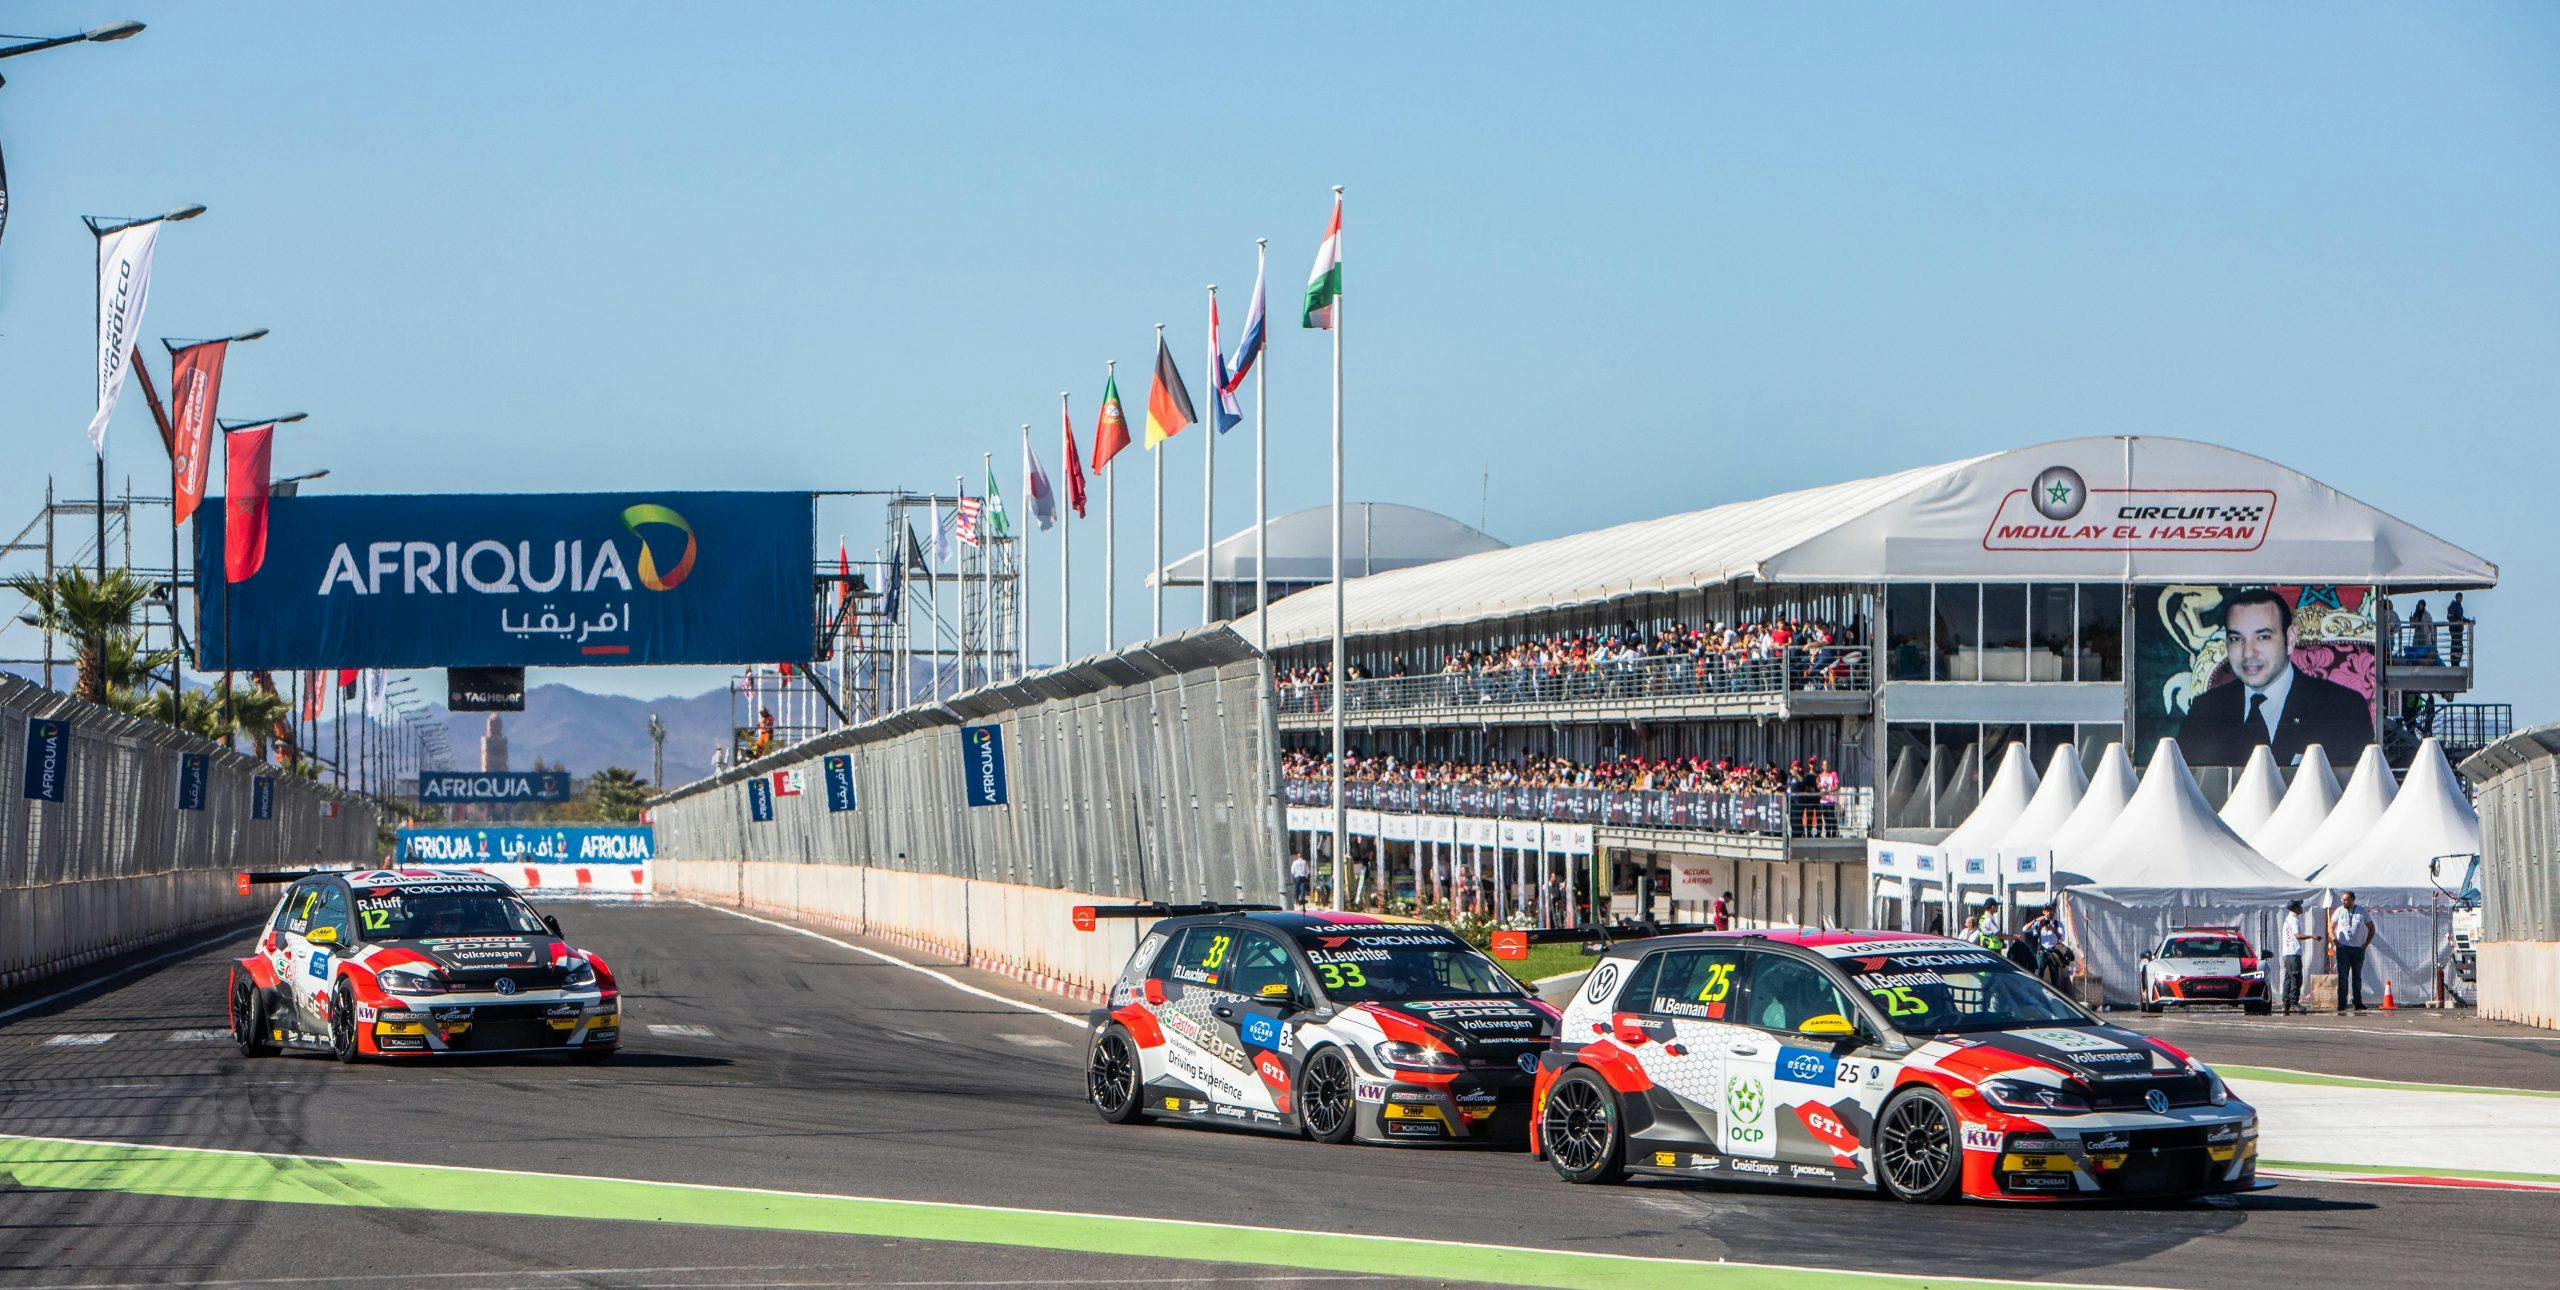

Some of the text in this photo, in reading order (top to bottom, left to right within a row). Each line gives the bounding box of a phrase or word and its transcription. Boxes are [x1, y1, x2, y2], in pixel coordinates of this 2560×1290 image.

[109, 258, 131, 378] OROCCO
[2117, 506, 2221, 520] CIRCUIT
[1997, 525, 2256, 539] MOULAY EL HASSAN
[317, 539, 633, 595] AFRIQUIA
[501, 602, 630, 643] افريقيا
[42, 736, 58, 798] AFRIQUIA
[981, 743, 997, 802] AFRIQUIA
[424, 777, 532, 798] AFRIQUIA
[404, 836, 474, 860] AFRIQUIA
[580, 835, 650, 859] AFRIQUIA
[368, 875, 487, 885] Volkswagen
[399, 885, 497, 895] YOKOHAMA
[357, 897, 401, 911] R.Huff
[360, 910, 391, 931] 12
[1305, 924, 1434, 933] Volkswagen
[432, 942, 532, 952] EDGE
[1350, 935, 1456, 946] YOKOHAMA
[1837, 941, 1969, 954] Volkswagen
[453, 951, 523, 960] Volkswagen
[1202, 935, 1231, 968] 33
[1307, 948, 1392, 965] B.Leuchter
[1889, 953, 1998, 967] YOKOHAMA
[1174, 964, 1210, 983] B.Leuchter
[1319, 962, 1367, 989] 33
[1852, 968, 1944, 991] M.Bennani
[1262, 984, 1288, 994] OMP
[1698, 963, 1736, 1002] 25
[1432, 1000, 1515, 1008] Castrol
[1653, 997, 1710, 1018] M.Bennani
[1870, 986, 1929, 1017] 25
[358, 1007, 376, 1019] KW
[1428, 1008, 1536, 1020] EDGE
[1171, 1013, 1198, 1040] Castrol
[1249, 1025, 1273, 1038] OSCARO
[1459, 1020, 1533, 1031] Volkswagen
[1197, 1029, 1247, 1069] EDGE
[2067, 1051, 2145, 1063] Volkswagen
[1262, 1061, 1285, 1083] GTI
[1787, 1060, 1825, 1074] OSCARO
[1837, 1063, 1860, 1083] 25
[1168, 1049, 1243, 1101] Driving Experience
[1358, 1085, 1384, 1100] KW
[1402, 1107, 1424, 1115] OMP
[1808, 1112, 1845, 1139] GTI
[1731, 1127, 1764, 1142] OCP
[1967, 1131, 2001, 1147] KW
[1656, 1154, 1676, 1165] OMP
[1731, 1158, 1780, 1176] CroisiEurope
[2022, 1158, 2047, 1167] OMP
[2025, 1178, 2066, 1186] YOKOHAMA
